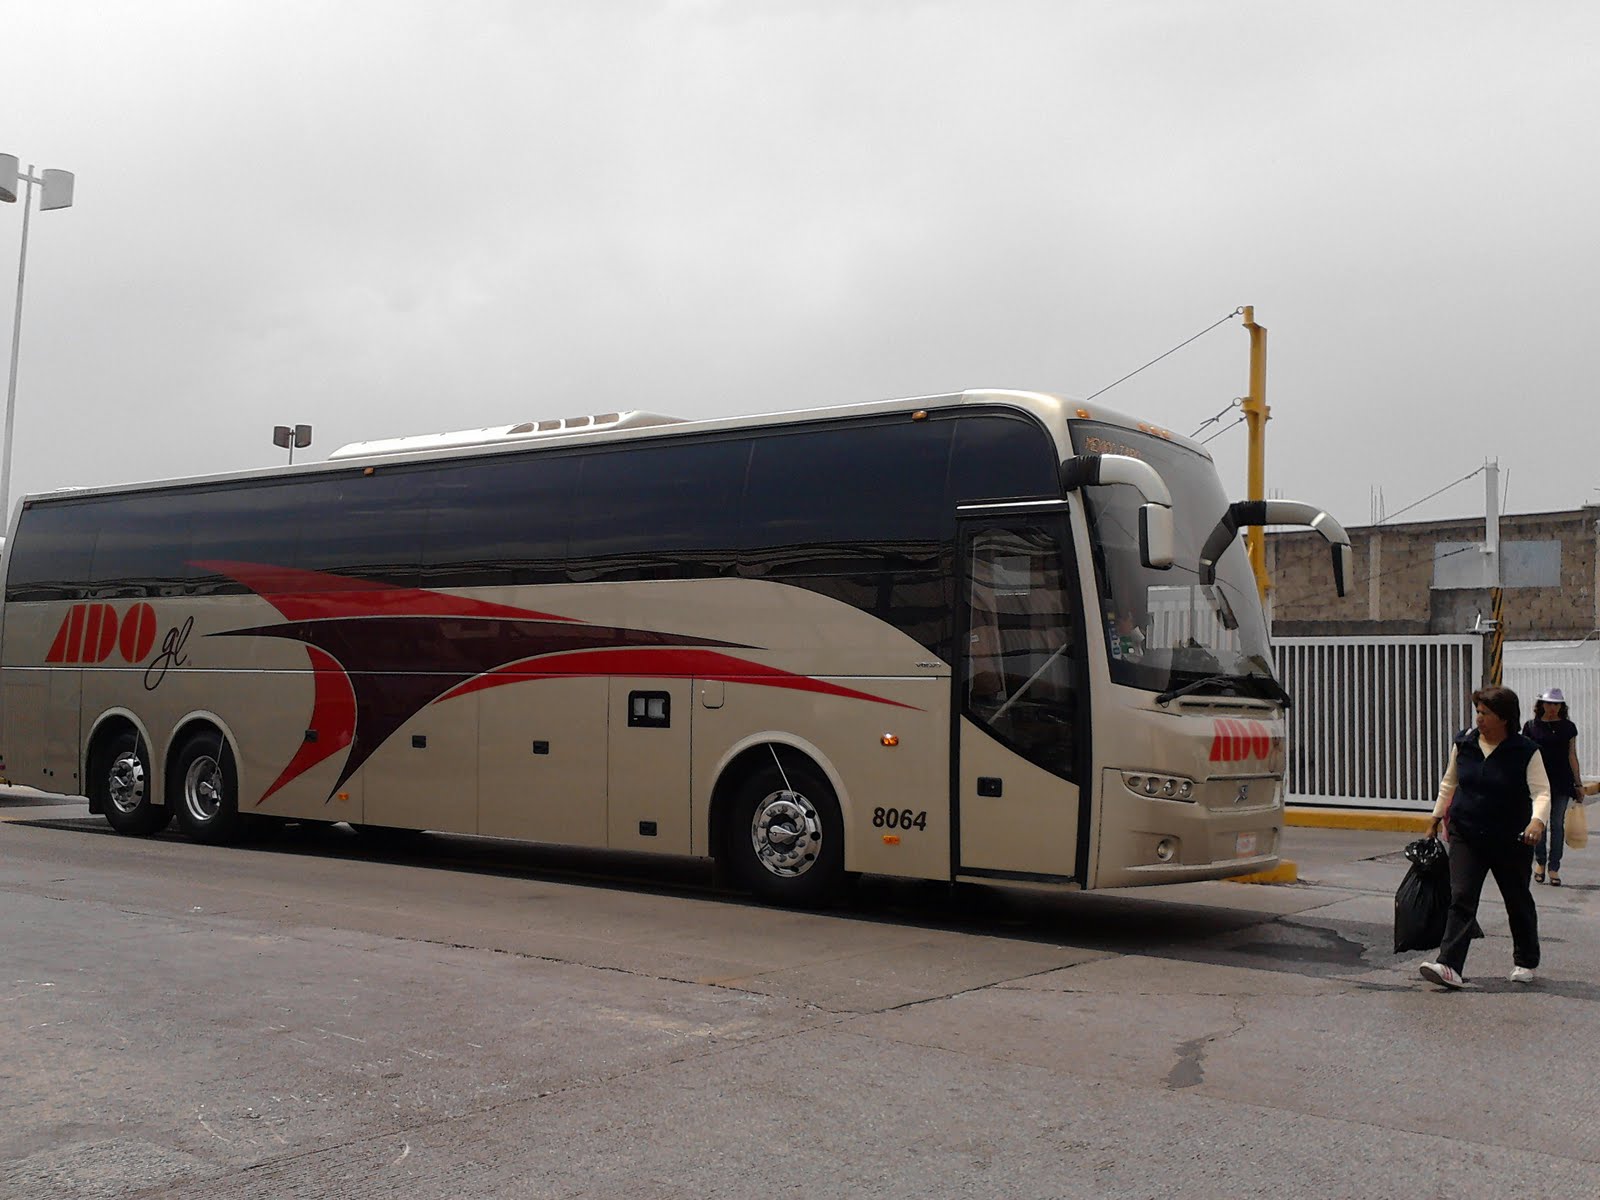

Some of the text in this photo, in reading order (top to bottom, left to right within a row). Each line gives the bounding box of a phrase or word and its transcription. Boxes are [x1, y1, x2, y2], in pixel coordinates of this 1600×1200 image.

[45, 602, 157, 662] ADO
[1208, 719, 1270, 761] ADO
[873, 807, 927, 831] 8064
